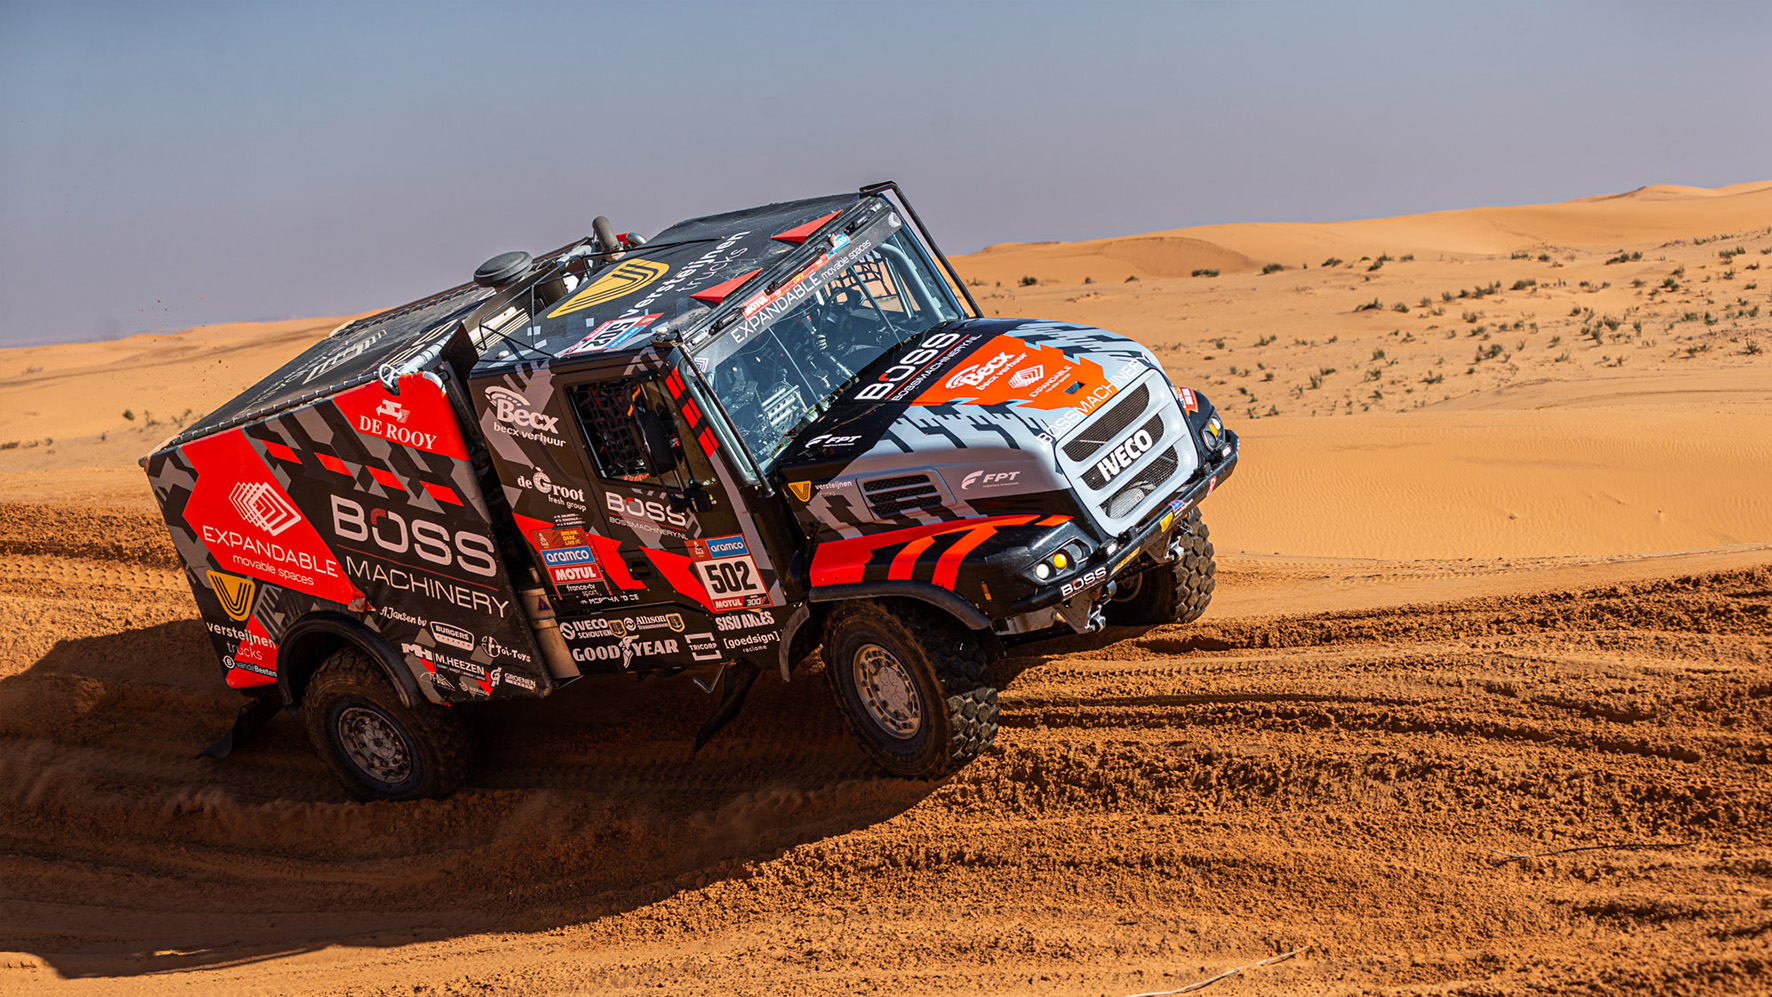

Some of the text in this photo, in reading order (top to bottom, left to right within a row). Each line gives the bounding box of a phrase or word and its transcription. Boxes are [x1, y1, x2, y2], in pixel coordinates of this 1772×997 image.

[618, 230, 751, 319] versteijnen
[675, 247, 748, 293] trucks
[730, 272, 822, 344] EXPANDABLE
[820, 256, 850, 281] movable
[848, 239, 872, 260] spaces
[743, 294, 769, 317] MOTUL
[853, 333, 961, 401] BOSS
[961, 351, 1016, 386] Becx
[975, 376, 1000, 391] becx
[496, 398, 559, 435] Becx
[358, 414, 438, 450] DE ROOY
[493, 421, 567, 448] becx verhuur
[824, 435, 863, 444] FPT
[1095, 428, 1153, 483] IVECO
[516, 471, 586, 503] de Groot
[982, 470, 1021, 484] FPT
[547, 493, 587, 513] fresh group
[605, 491, 687, 527] BOSS
[329, 493, 497, 578] BOSS
[710, 541, 744, 553] aramco
[202, 525, 339, 578] EXPANDABLE
[546, 550, 590, 563] aramco
[232, 554, 315, 586] movable spaces
[555, 566, 597, 582] MOTUL
[704, 560, 758, 594] 502
[1060, 566, 1108, 597] BOSS
[345, 555, 509, 619] MACHINERY
[715, 598, 743, 609] MOTUL
[435, 625, 470, 641] BURGERS
[572, 618, 609, 632] IVECO
[635, 614, 667, 626] Allison
[715, 615, 742, 632] SISU
[206, 621, 277, 650] versteijnen
[688, 642, 718, 652] TRICORP
[226, 641, 263, 661] trucks
